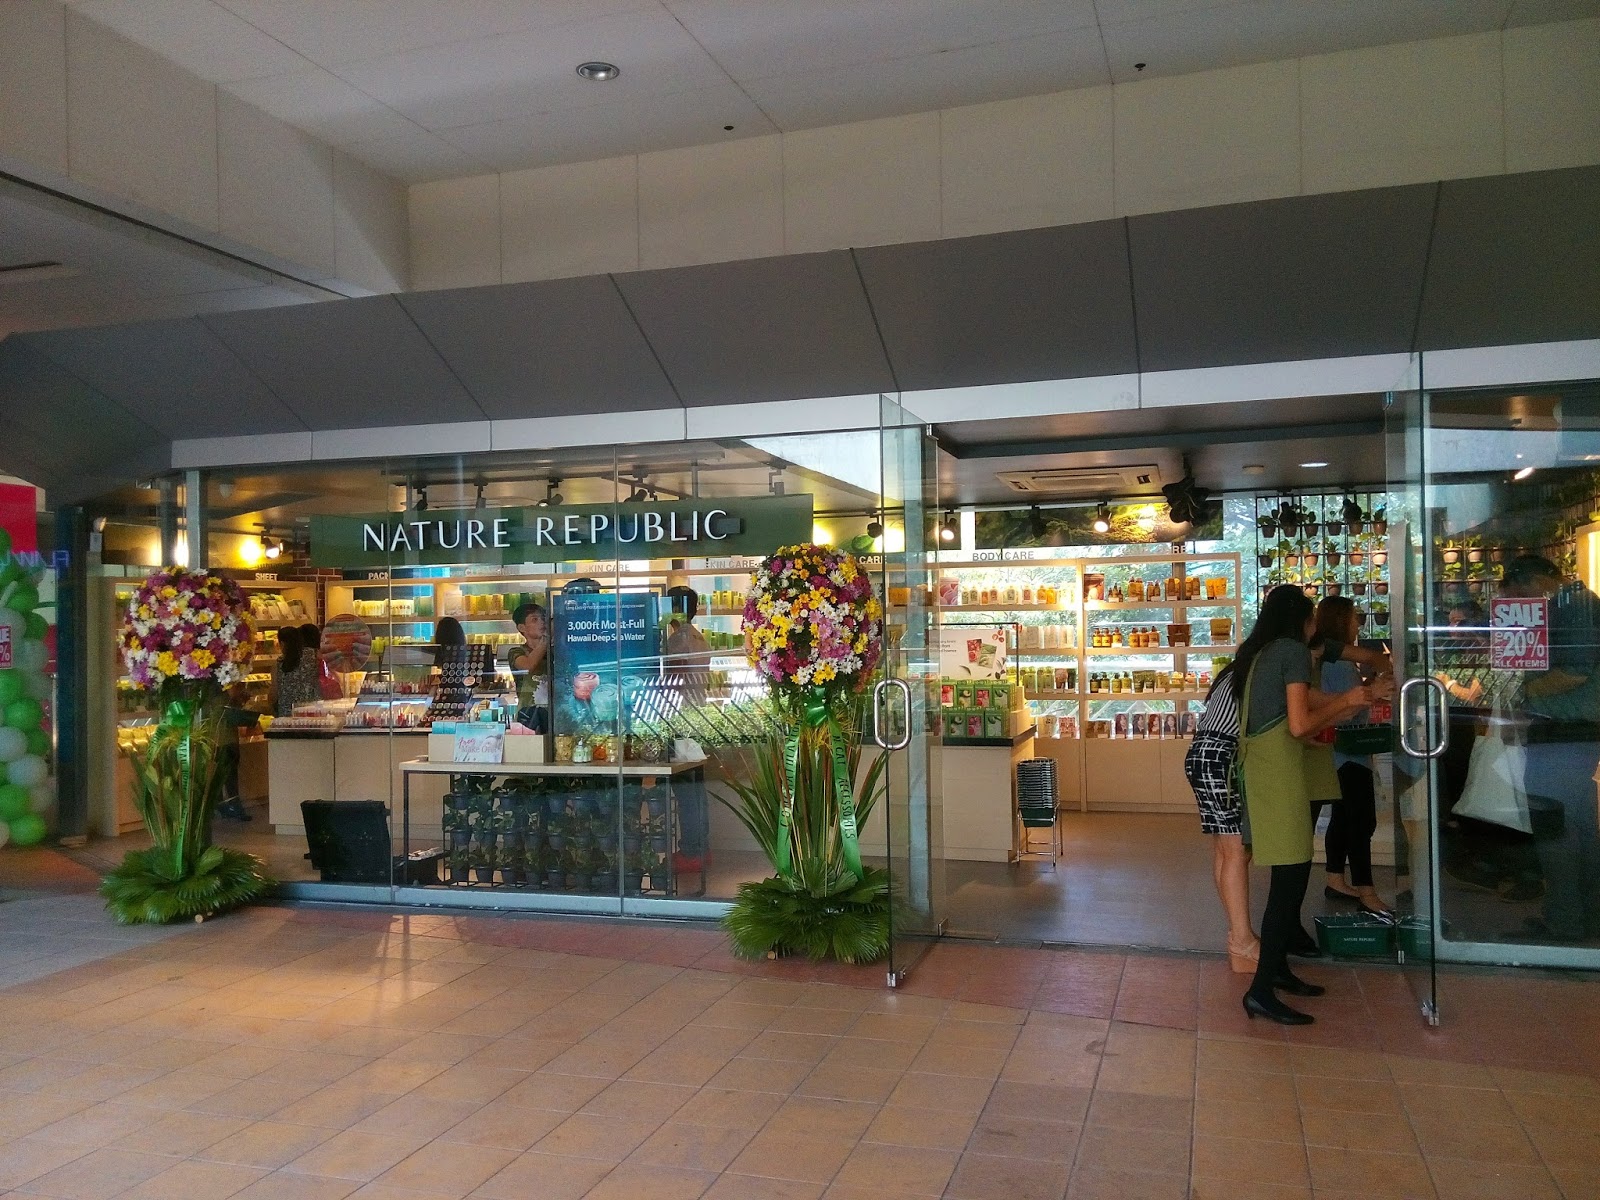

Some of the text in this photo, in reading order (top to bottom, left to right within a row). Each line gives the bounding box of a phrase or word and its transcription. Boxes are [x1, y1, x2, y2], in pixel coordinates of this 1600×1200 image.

[362, 509, 728, 552] NATURE REPUBLIC
[972, 551, 1035, 561] BODY CARE
[605, 563, 630, 573] CARE
[705, 559, 755, 569] KIN CARE
[255, 572, 279, 581] SHEET
[1494, 603, 1545, 628] SALE
[567, 619, 645, 631] 3,000ft Most-Full
[567, 633, 646, 643] Hawaii Deep Sa Water
[1504, 631, 1545, 657] 20%
[1494, 659, 1547, 667] ALL ITEMS
